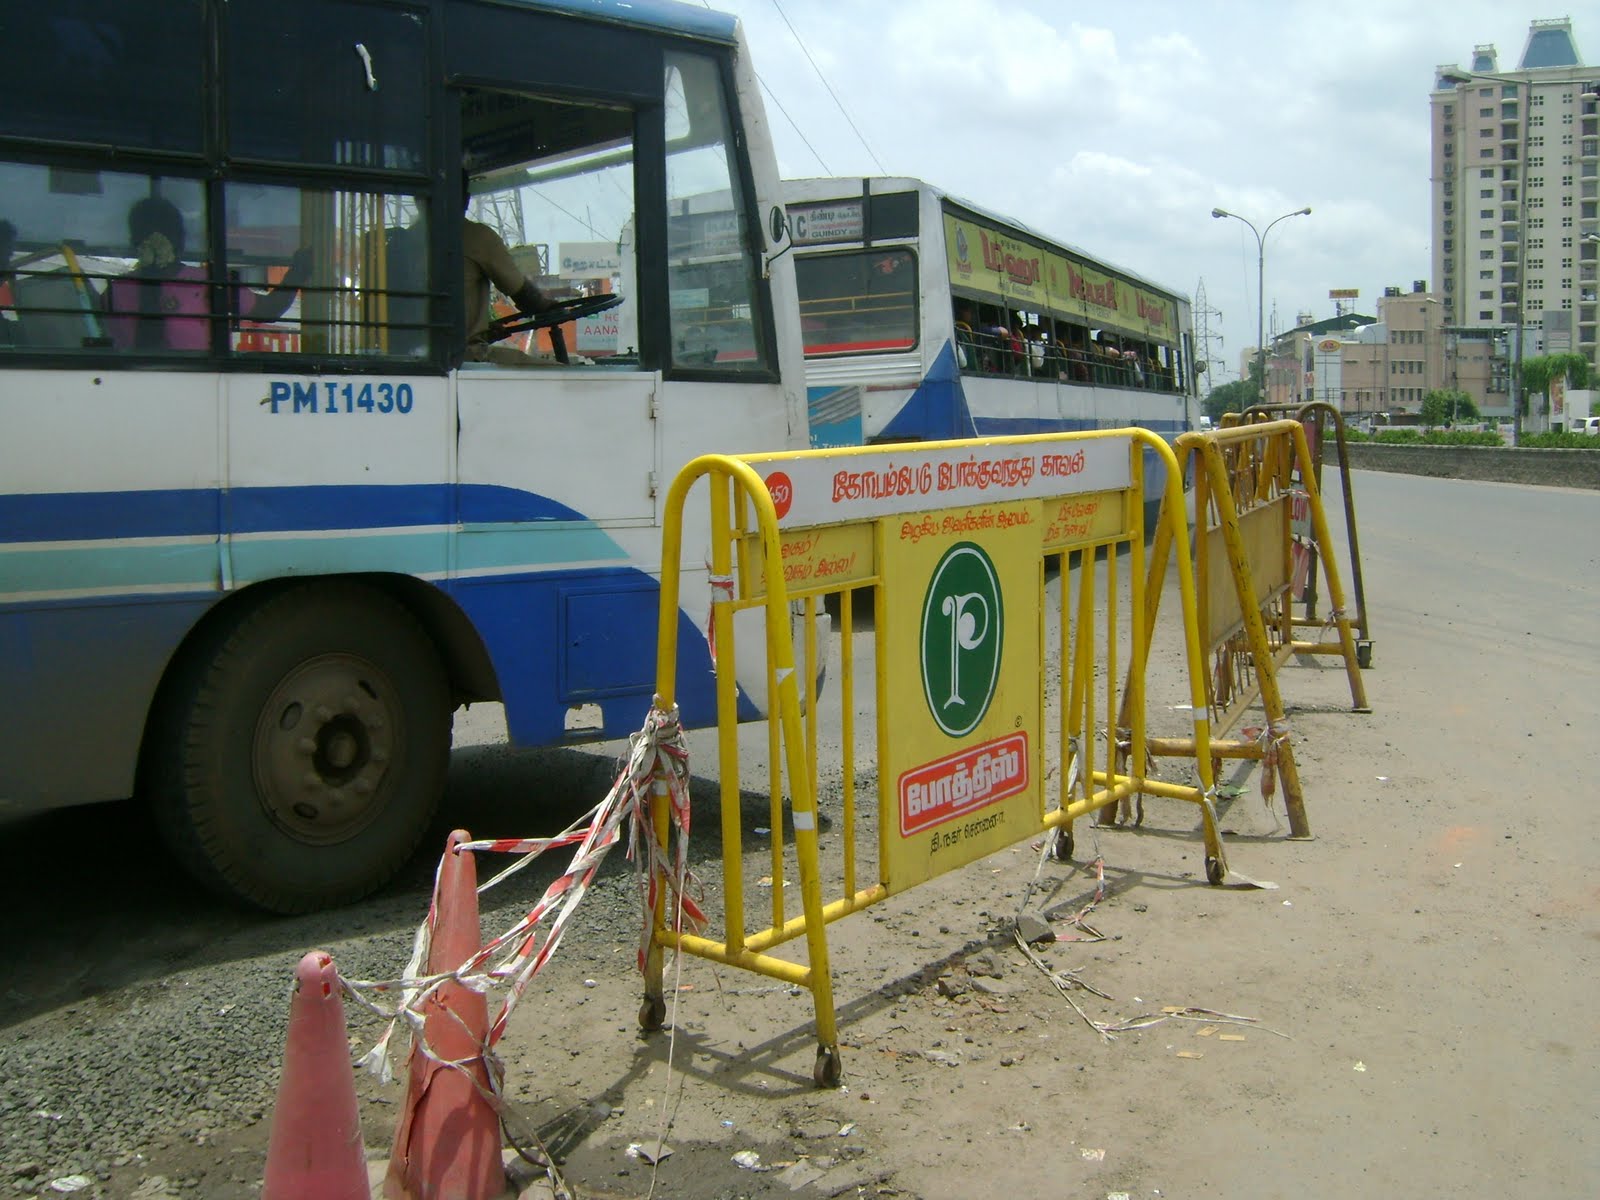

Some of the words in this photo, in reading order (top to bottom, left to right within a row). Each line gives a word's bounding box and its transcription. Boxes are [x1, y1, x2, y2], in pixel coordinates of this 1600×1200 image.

[811, 229, 848, 238] GUINDY
[832, 462, 932, 503] கோயம்பேடு
[937, 454, 1035, 491] போக்குவரத்து
[1040, 449, 1085, 477] காவல்
[907, 748, 1019, 817] போத்தீஸ்
